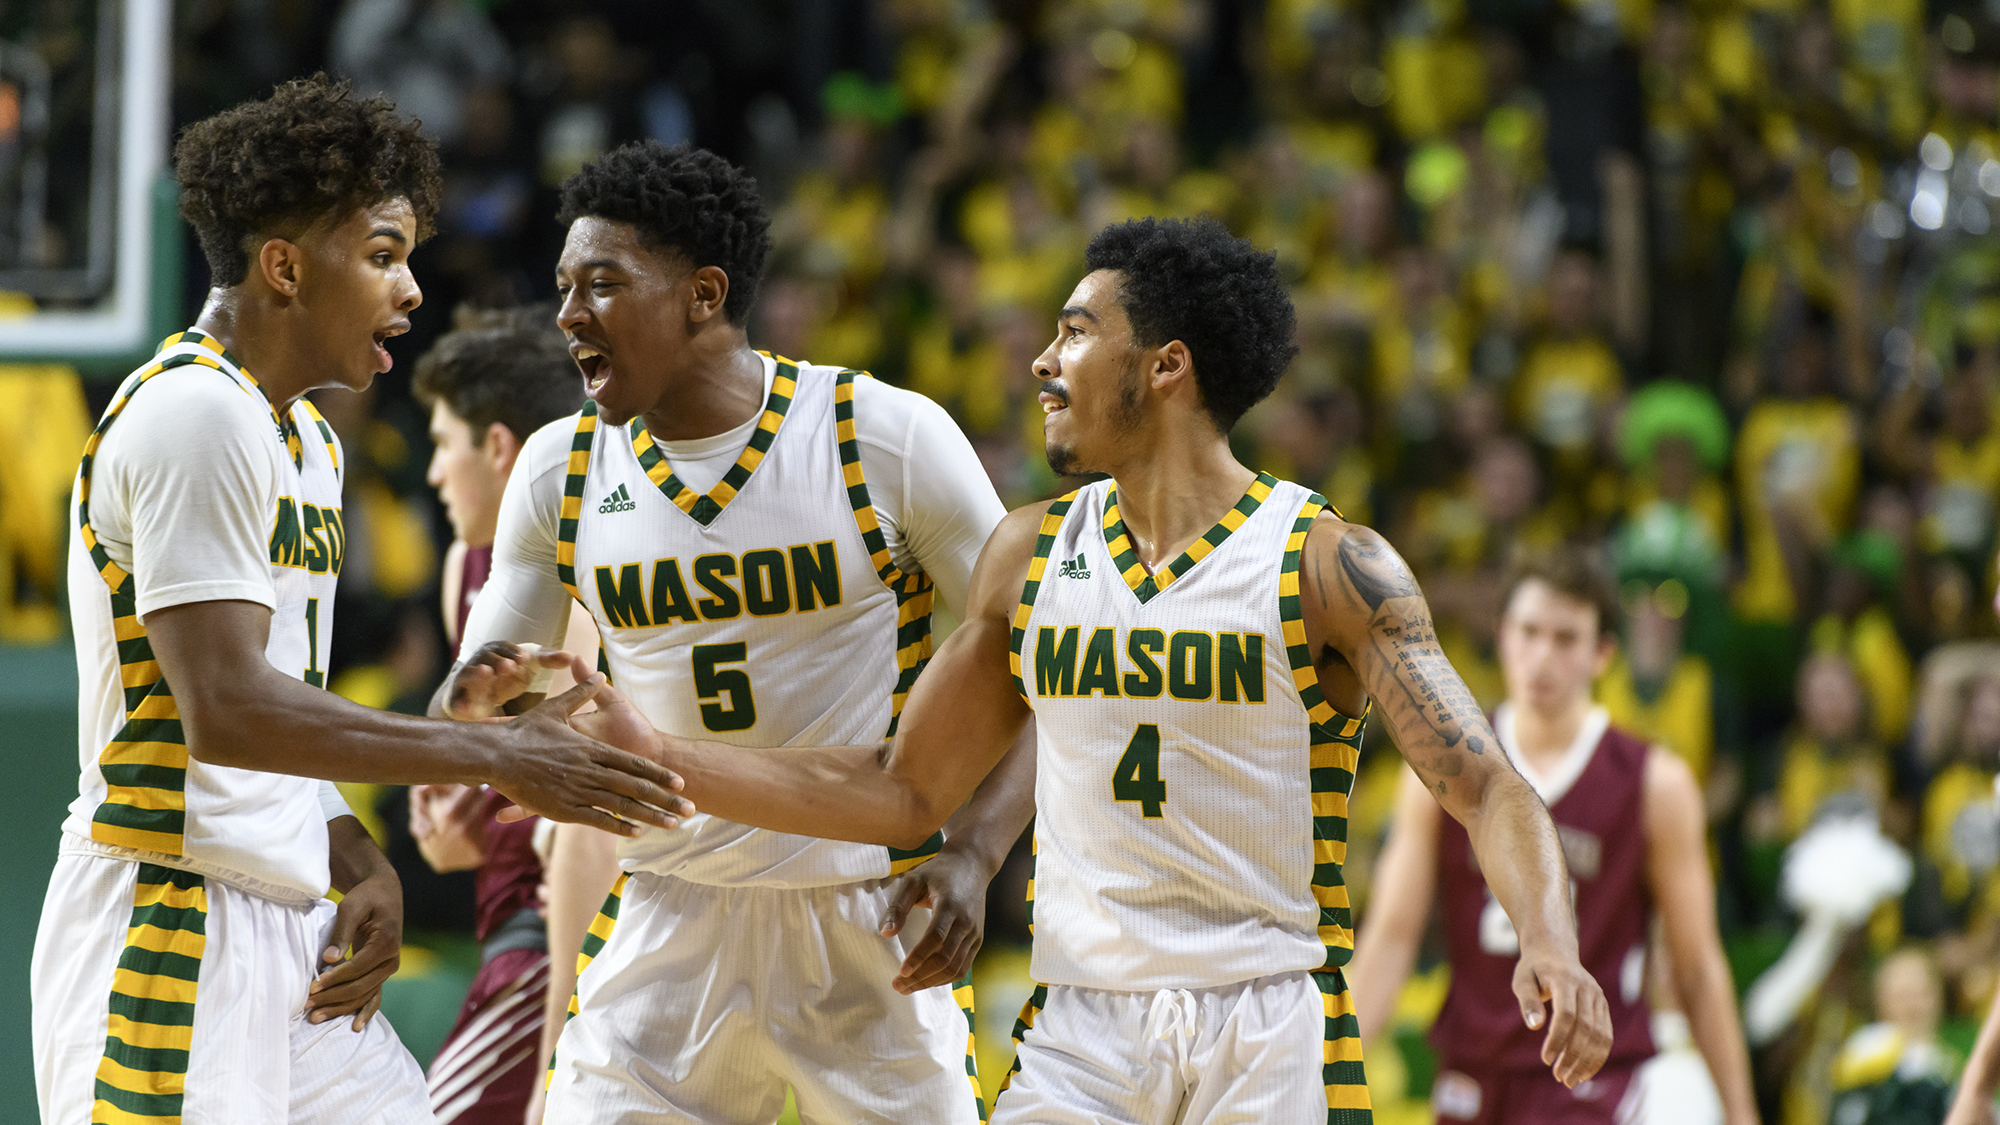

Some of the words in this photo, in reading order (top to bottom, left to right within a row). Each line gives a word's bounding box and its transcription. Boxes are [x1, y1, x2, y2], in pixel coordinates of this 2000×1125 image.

[268, 495, 346, 577] MSO
[598, 500, 636, 514] adidas
[594, 539, 842, 630] MASON
[304, 597, 325, 690] 1
[692, 641, 757, 733] 5
[1034, 625, 1267, 704] MASON
[1111, 722, 1167, 820] 4
